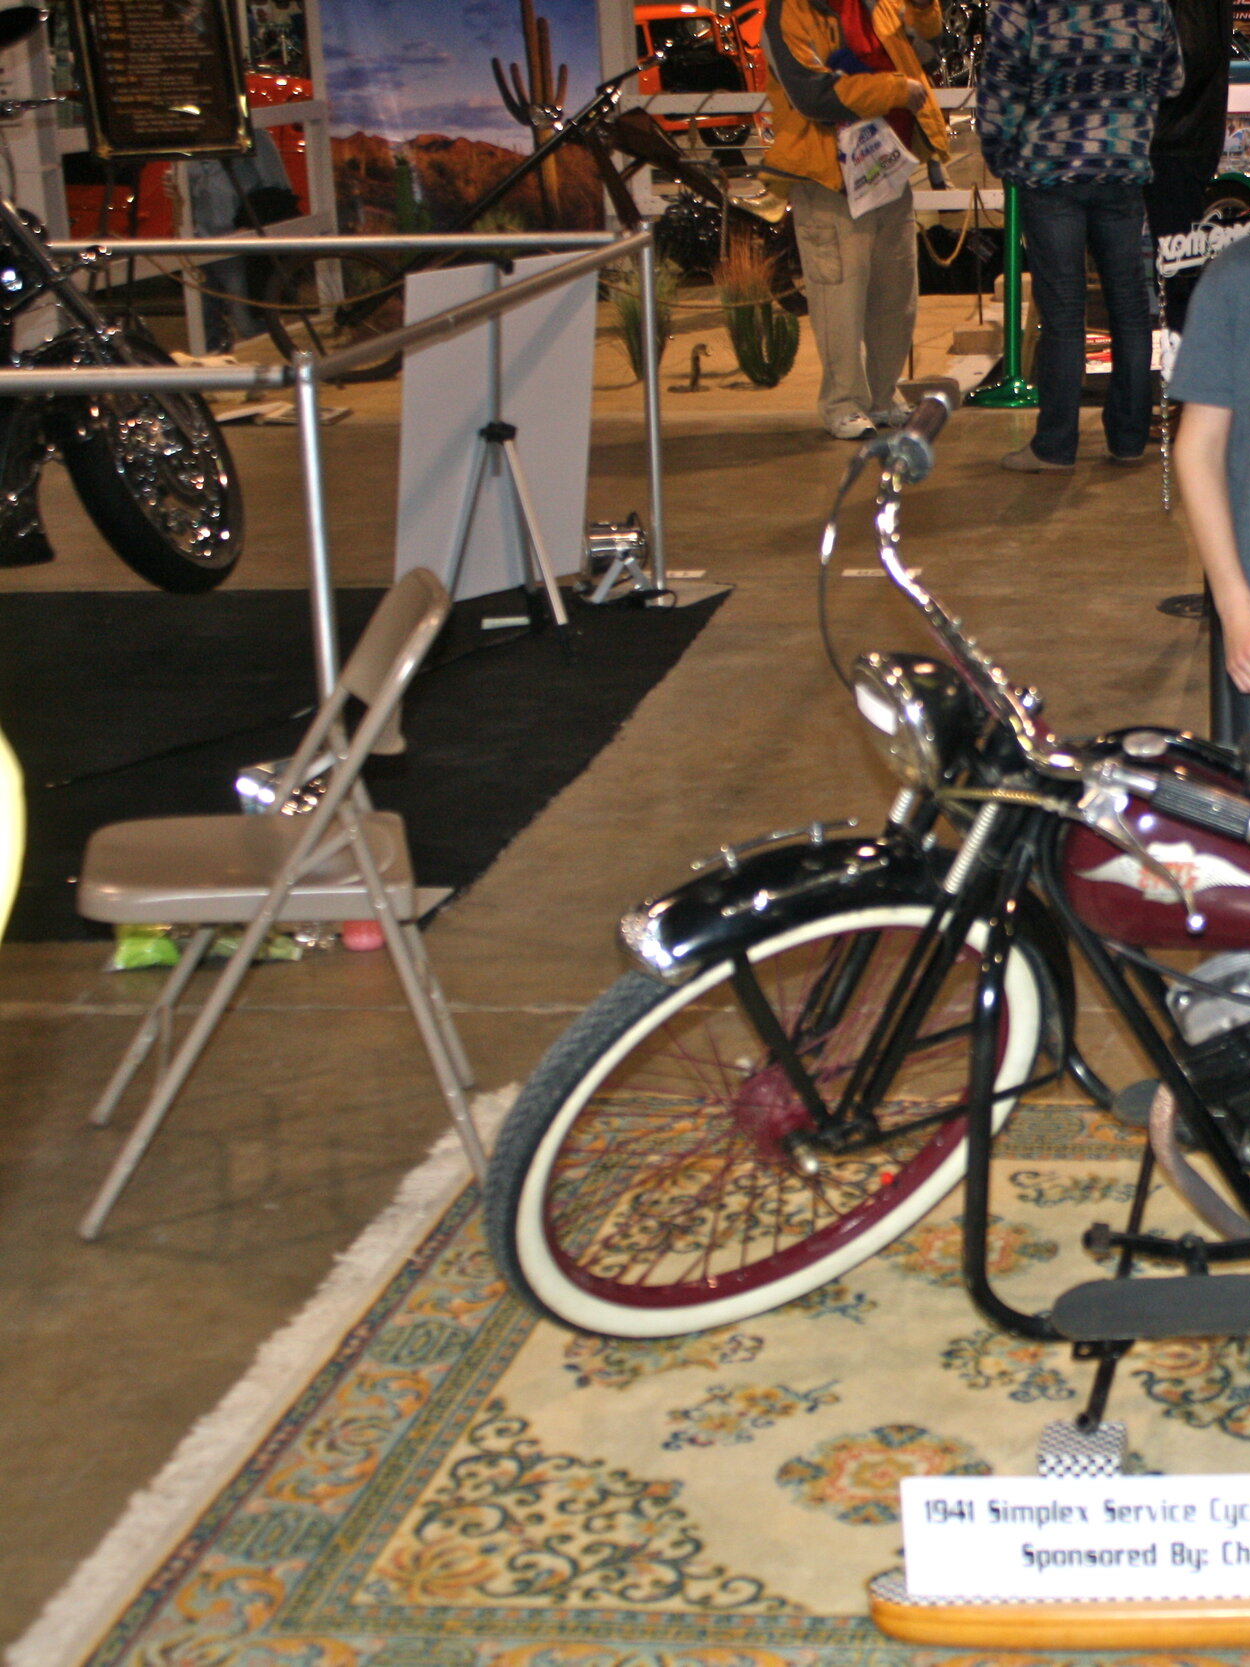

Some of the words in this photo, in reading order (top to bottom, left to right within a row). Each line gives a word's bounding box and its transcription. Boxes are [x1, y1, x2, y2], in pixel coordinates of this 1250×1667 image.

[925, 1499, 974, 1523] 1941
[988, 1500, 1089, 1529] Simplex
[1104, 1499, 1197, 1523] Service
[1022, 1542, 1157, 1572] Sponsored
[1171, 1541, 1209, 1572] By:
